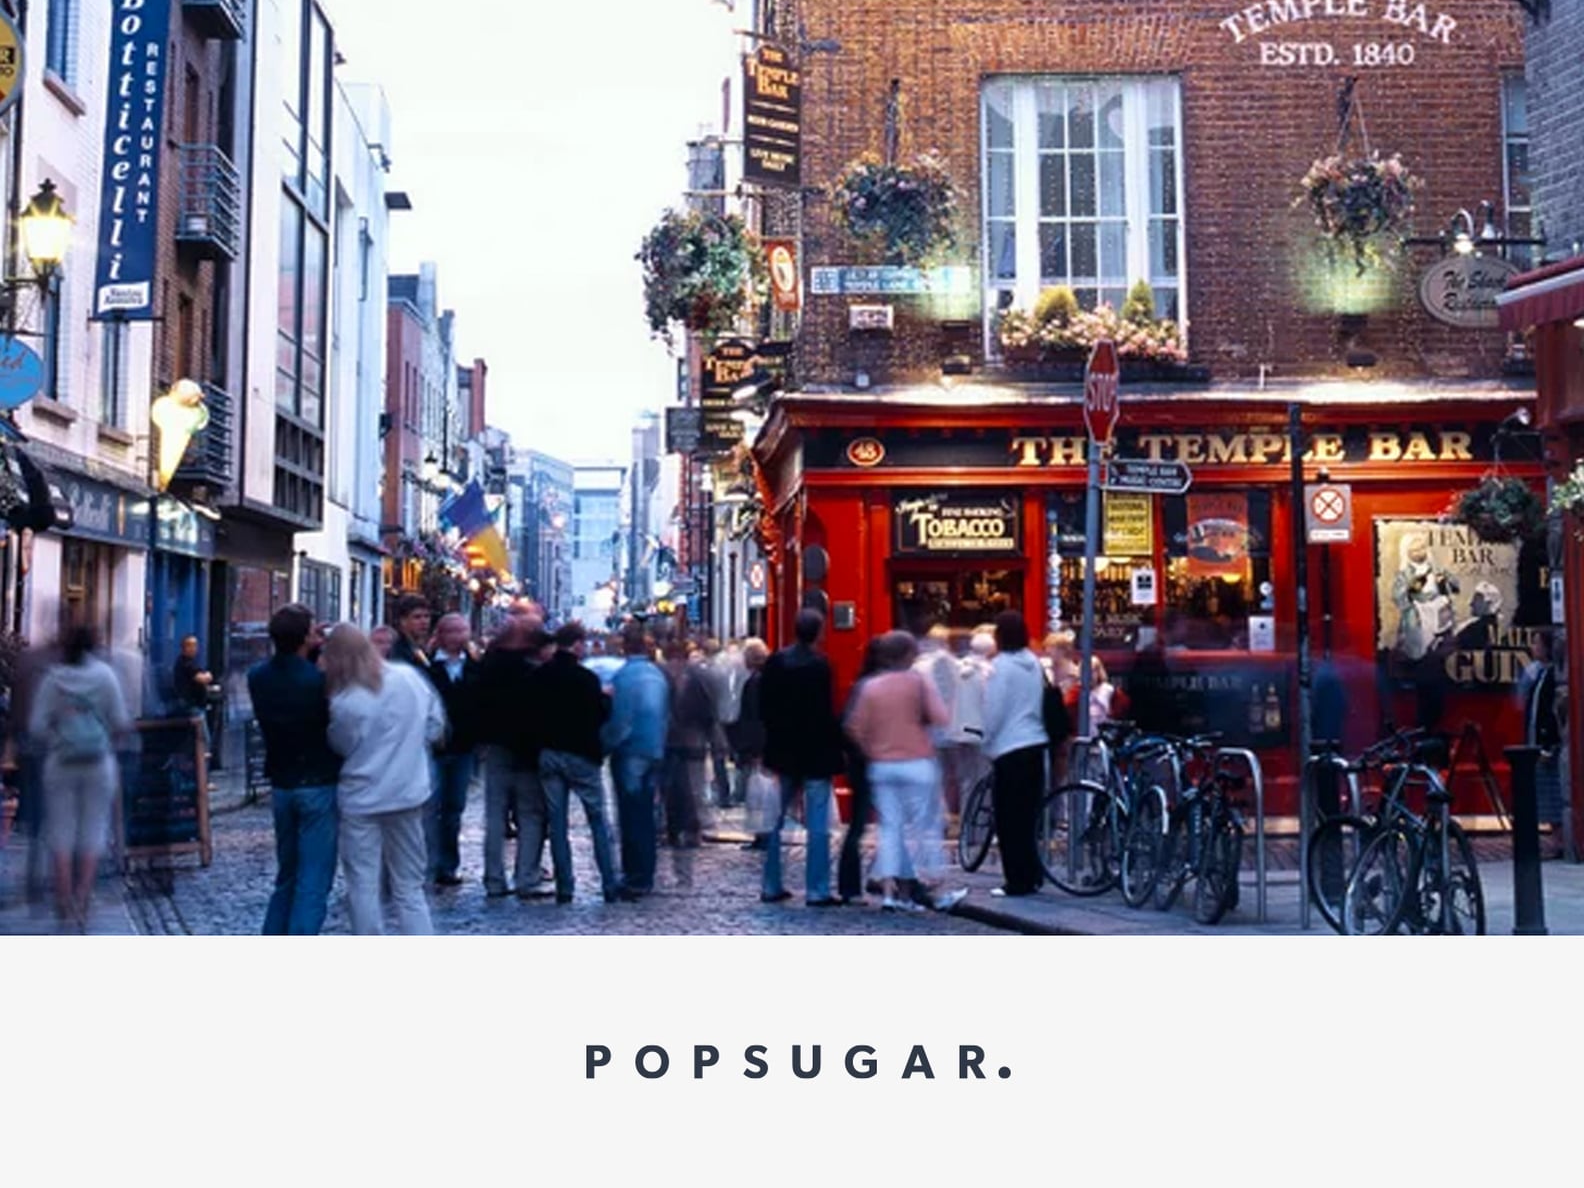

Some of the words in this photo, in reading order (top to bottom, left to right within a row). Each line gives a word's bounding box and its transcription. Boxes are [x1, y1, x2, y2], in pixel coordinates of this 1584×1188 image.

[1259, 42, 1340, 65] ESTD.
[1352, 43, 1415, 65] 1840
[136, 42, 160, 223] RESTAURANT
[1369, 430, 1473, 461] BAR
[909, 512, 1006, 546] TOBACCO
[1452, 548, 1495, 566] BAR
